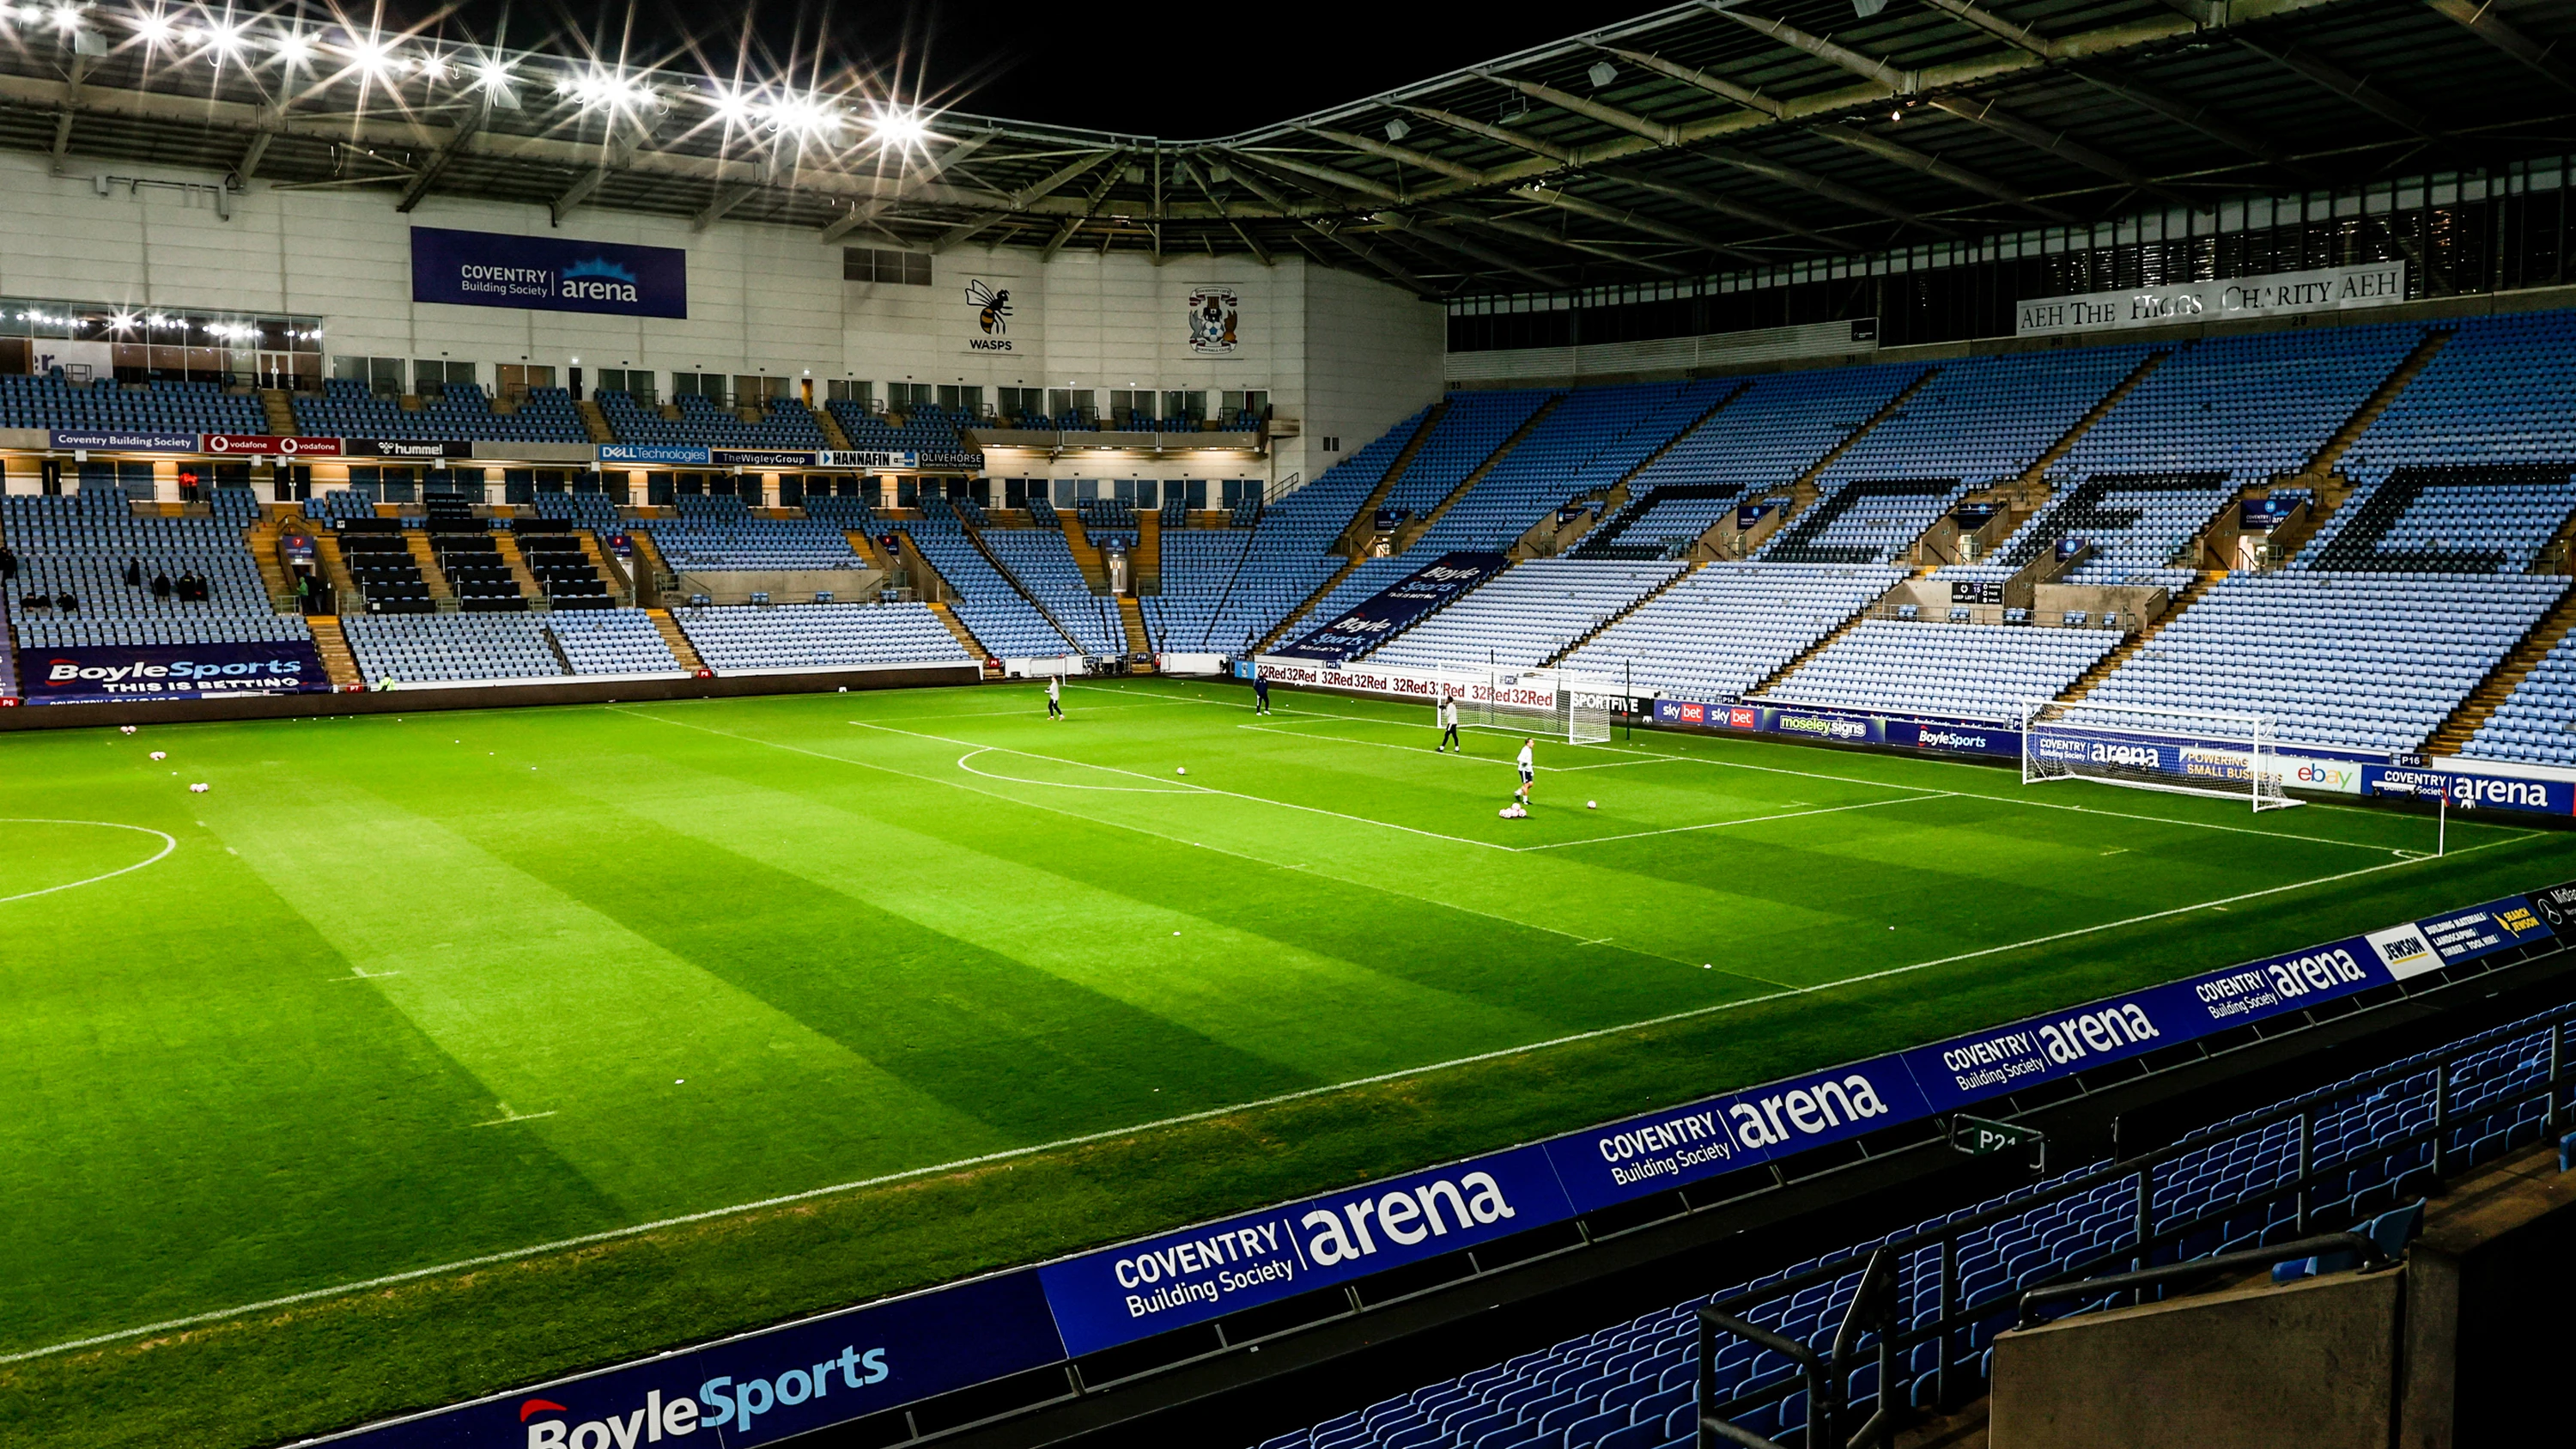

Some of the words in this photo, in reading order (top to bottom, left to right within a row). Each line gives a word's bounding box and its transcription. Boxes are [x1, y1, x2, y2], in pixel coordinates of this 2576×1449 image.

[461, 265, 546, 283] COVENTRY
[461, 280, 507, 295] Building
[509, 283, 548, 298] Society
[562, 280, 638, 302] arena
[2020, 306, 2063, 328] AEH
[2342, 272, 2397, 298] AEH
[969, 339, 1012, 350] WASPS
[58, 434, 107, 447] Coventry
[109, 436, 153, 448] Building
[154, 439, 191, 449] Society
[229, 441, 268, 449] vodafone
[299, 442, 336, 451] vodafone
[395, 443, 443, 455] hummel
[636, 447, 706, 462] Technologies
[832, 452, 890, 466] HANNAFIN
[921, 453, 982, 463] OLIVEHORSE
[48, 659, 302, 682] BoyleSports
[1287, 667, 1316, 683] 32Red
[102, 682, 162, 693] THIS
[168, 681, 191, 691] IS
[1321, 671, 1353, 687] 32Red
[1354, 673, 1387, 691] 32Red
[1393, 678, 1428, 695] 32Red
[1472, 685, 1510, 703] 32Red
[1511, 689, 1552, 707] 32Red
[1573, 691, 1639, 713] SPORTFIVE
[1663, 705, 1680, 720] sky
[1683, 707, 1701, 719] bet
[1711, 711, 1729, 725] sky
[1732, 712, 1752, 725] bet
[1919, 730, 1987, 748] BoyleSports
[2040, 738, 2087, 752] COVENTRY
[2040, 748, 2063, 759] Building
[2063, 751, 2087, 761] Society
[2091, 742, 2160, 768] arena
[2188, 752, 2249, 767] POWERING
[2402, 756, 2421, 765] P16
[2187, 763, 2224, 777] SMALL
[2298, 763, 2353, 788] ebay
[2385, 770, 2447, 787] COVENTRY
[2453, 776, 2549, 807] arena
[2502, 907, 2531, 922] SEARCH
[2424, 920, 2454, 935] BUILDING
[2511, 916, 2540, 932] JEWSON
[2383, 936, 2425, 960] JEWSON
[2268, 948, 2366, 999] arena
[2196, 970, 2266, 1003] COVENTRY
[2208, 996, 2250, 1020] Building
[2245, 991, 2278, 1009] Society
[2038, 1003, 2160, 1064] arena
[1943, 1032, 2032, 1072] COVENTRY
[1955, 1068, 2008, 1092] Building
[2005, 1056, 2045, 1078] Society
[1728, 1075, 1888, 1149] arena
[1599, 1111, 1717, 1162] COVENTRY
[1611, 1156, 1679, 1186] Building
[1676, 1141, 1731, 1168] Society
[1300, 1170, 1516, 1267] arena
[1115, 1221, 1279, 1289] COVENTRY
[1125, 1279, 1219, 1318] Building
[1223, 1259, 1293, 1293] Society
